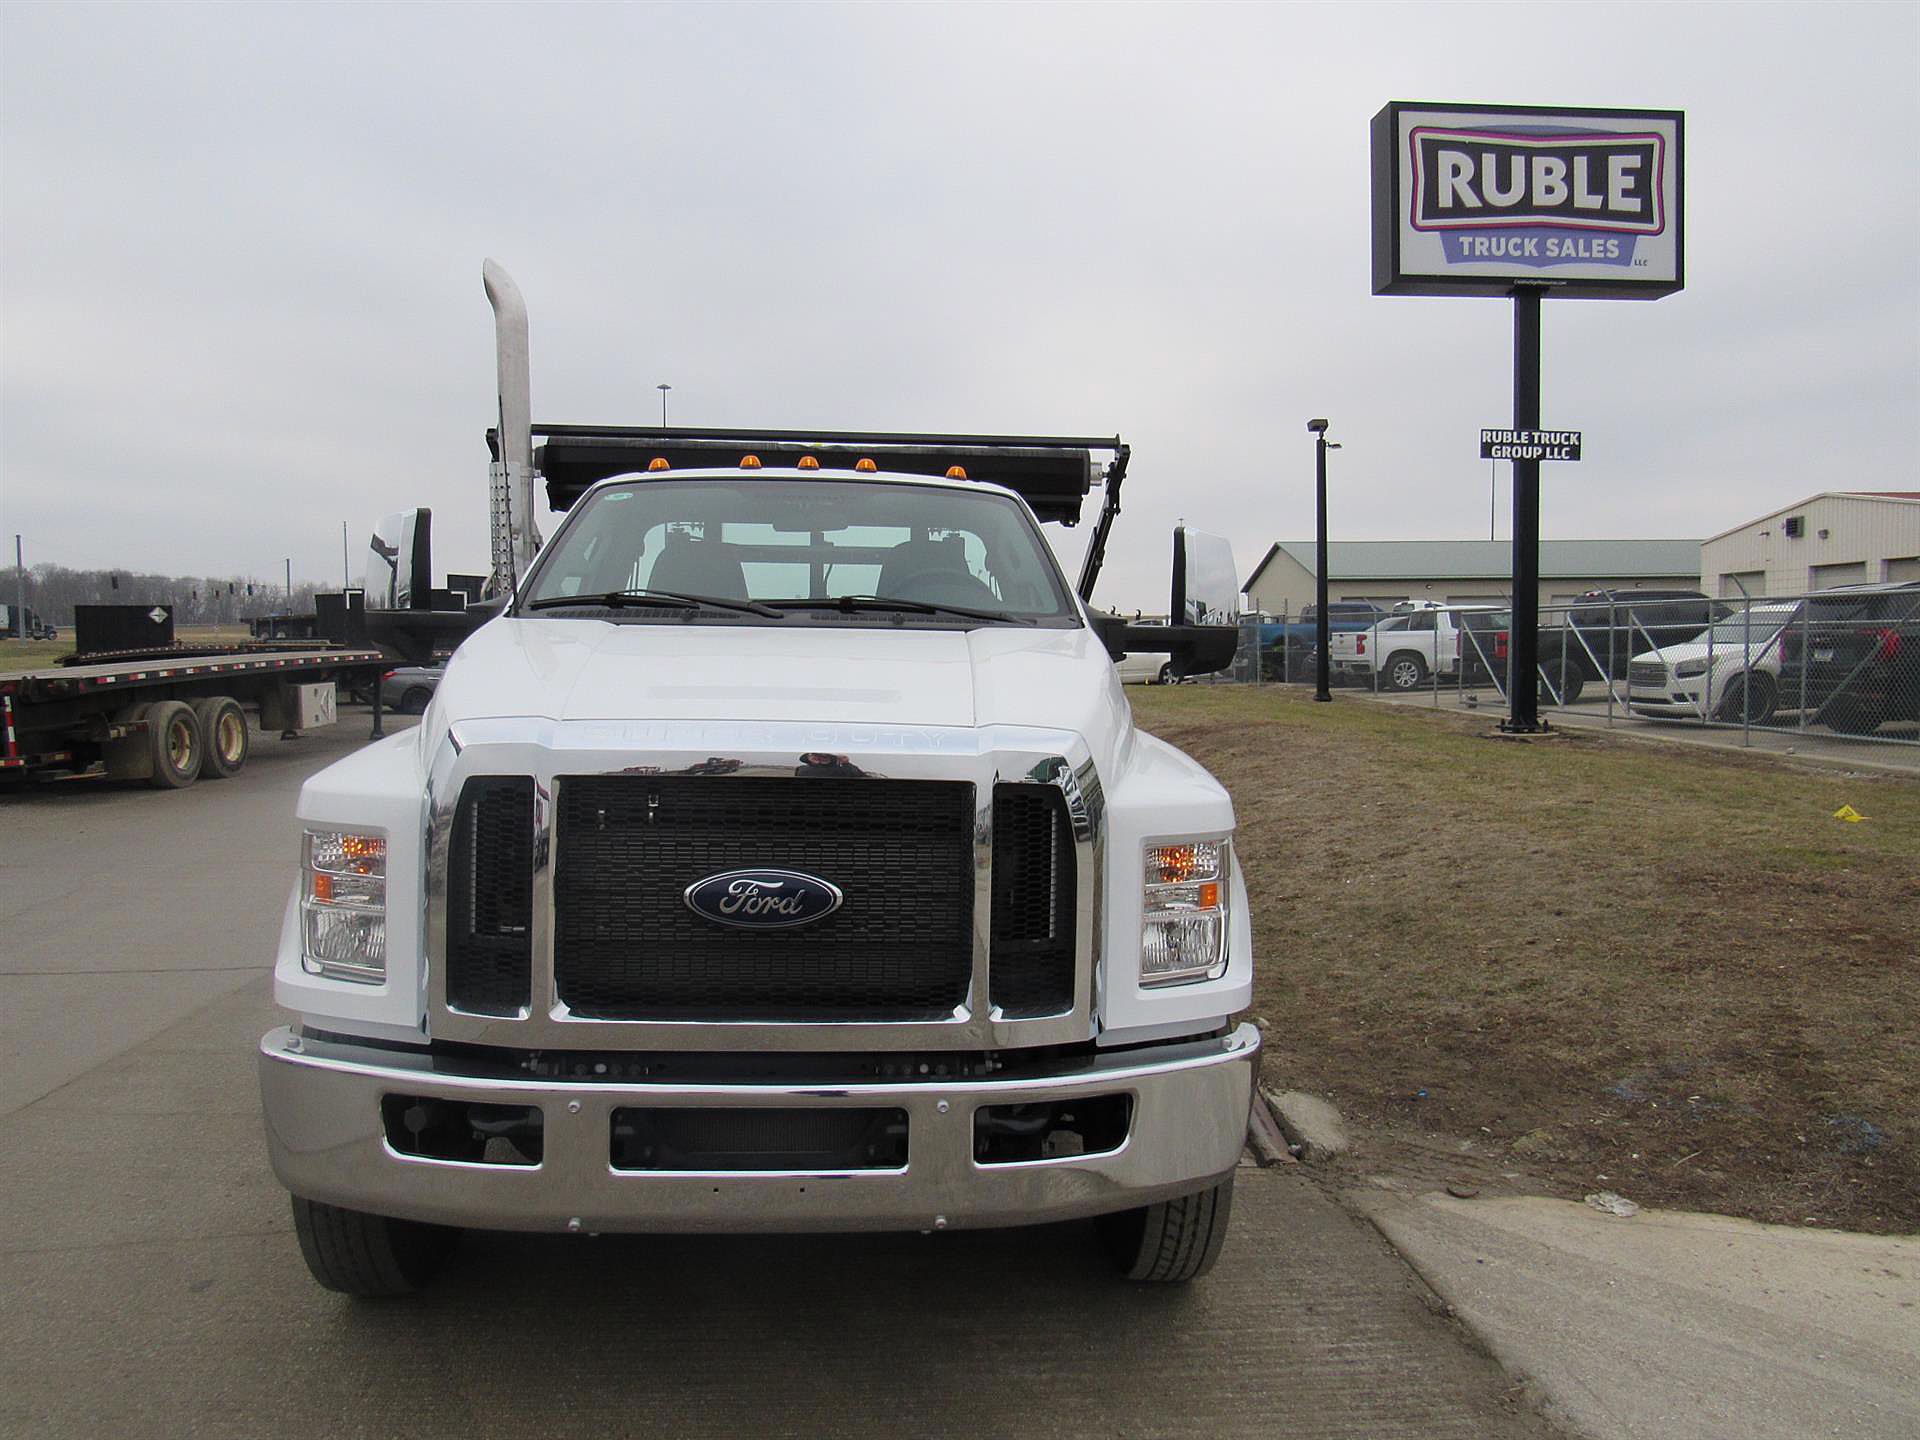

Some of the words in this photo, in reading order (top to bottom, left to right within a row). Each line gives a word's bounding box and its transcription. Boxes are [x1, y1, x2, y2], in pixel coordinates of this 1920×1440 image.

[1437, 149, 1642, 212] RUBLE
[1459, 236, 1539, 257] TRUCK
[1545, 238, 1620, 259] SALES
[1633, 258, 1648, 267] LLC
[1482, 431, 1529, 444] RUBLE
[1531, 432, 1579, 445] TRUCK
[1491, 446, 1542, 459] GROUP
[1545, 447, 1570, 460] LLC
[801, 726, 951, 750] DUTY
[719, 879, 806, 914] Ford
